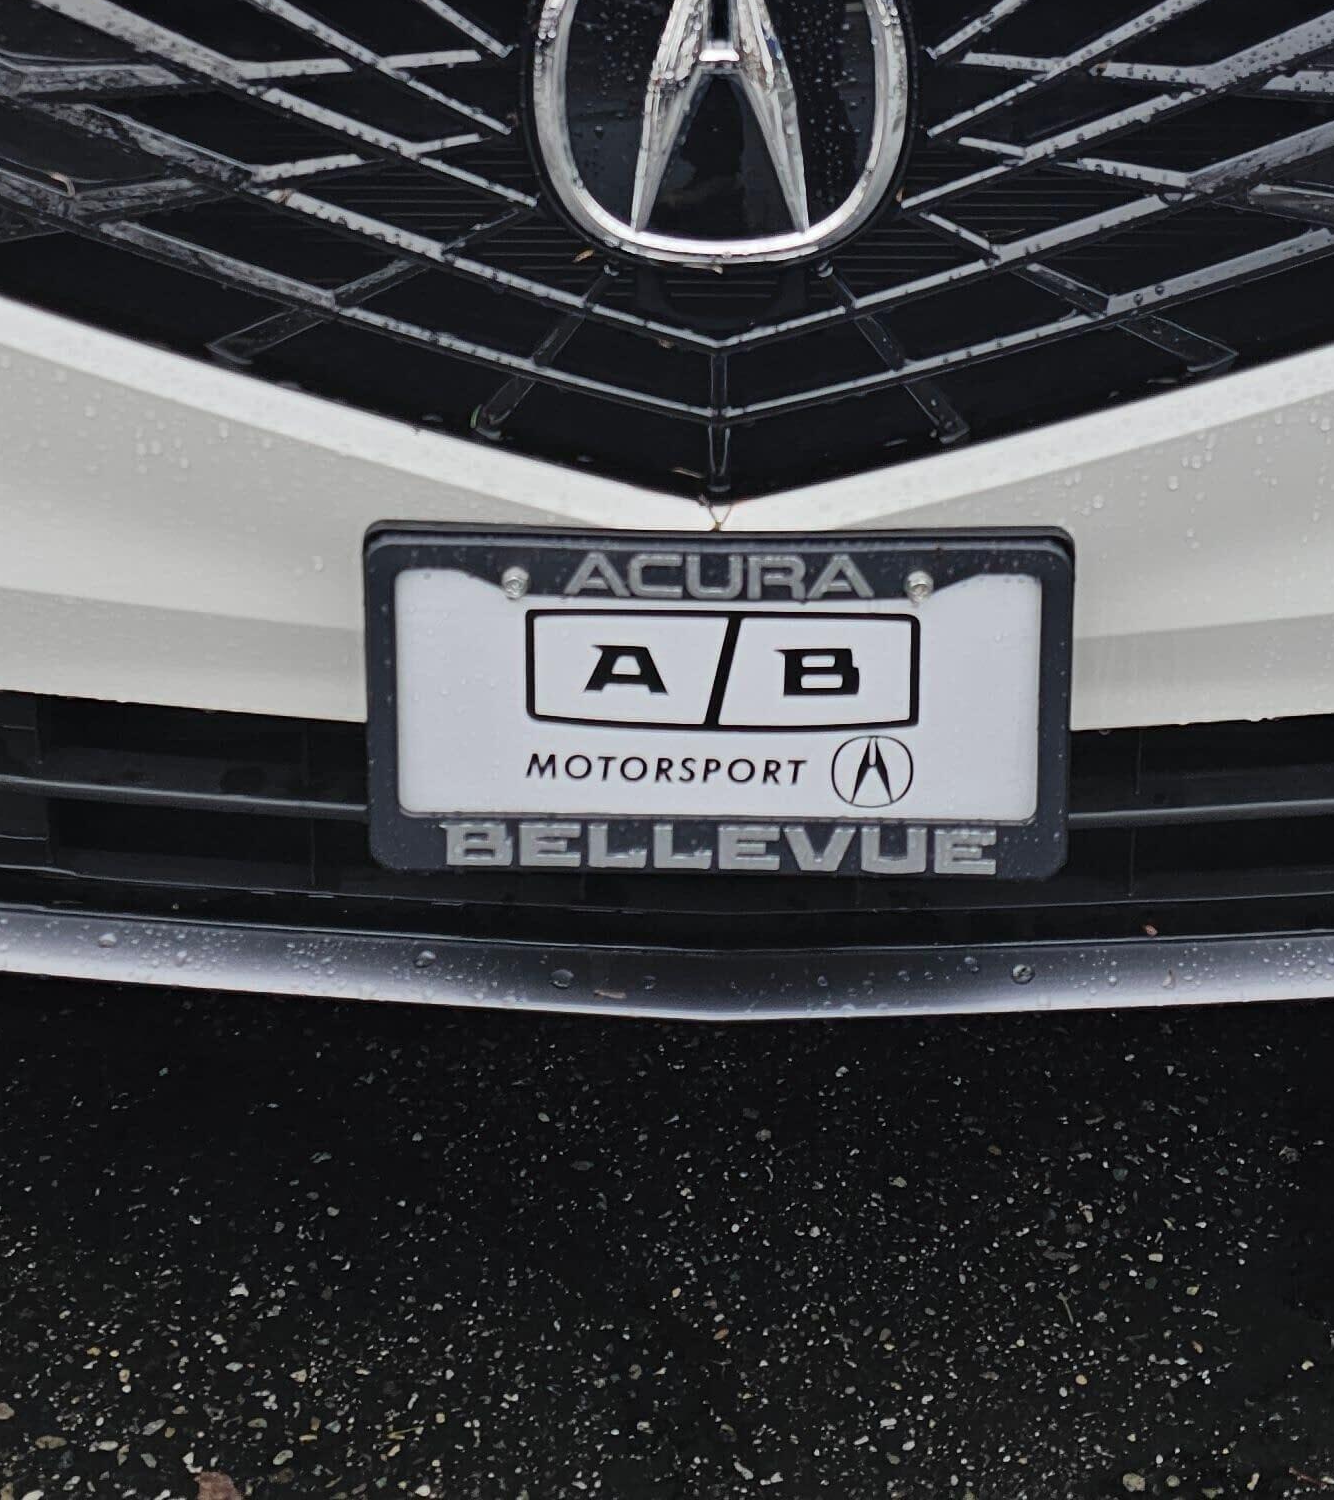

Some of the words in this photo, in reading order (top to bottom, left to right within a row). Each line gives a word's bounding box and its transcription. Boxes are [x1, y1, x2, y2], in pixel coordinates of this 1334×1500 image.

[564, 552, 875, 601] ACURA
[525, 751, 809, 788] MOTORSPORT
[439, 822, 998, 876] BELLEVUE
